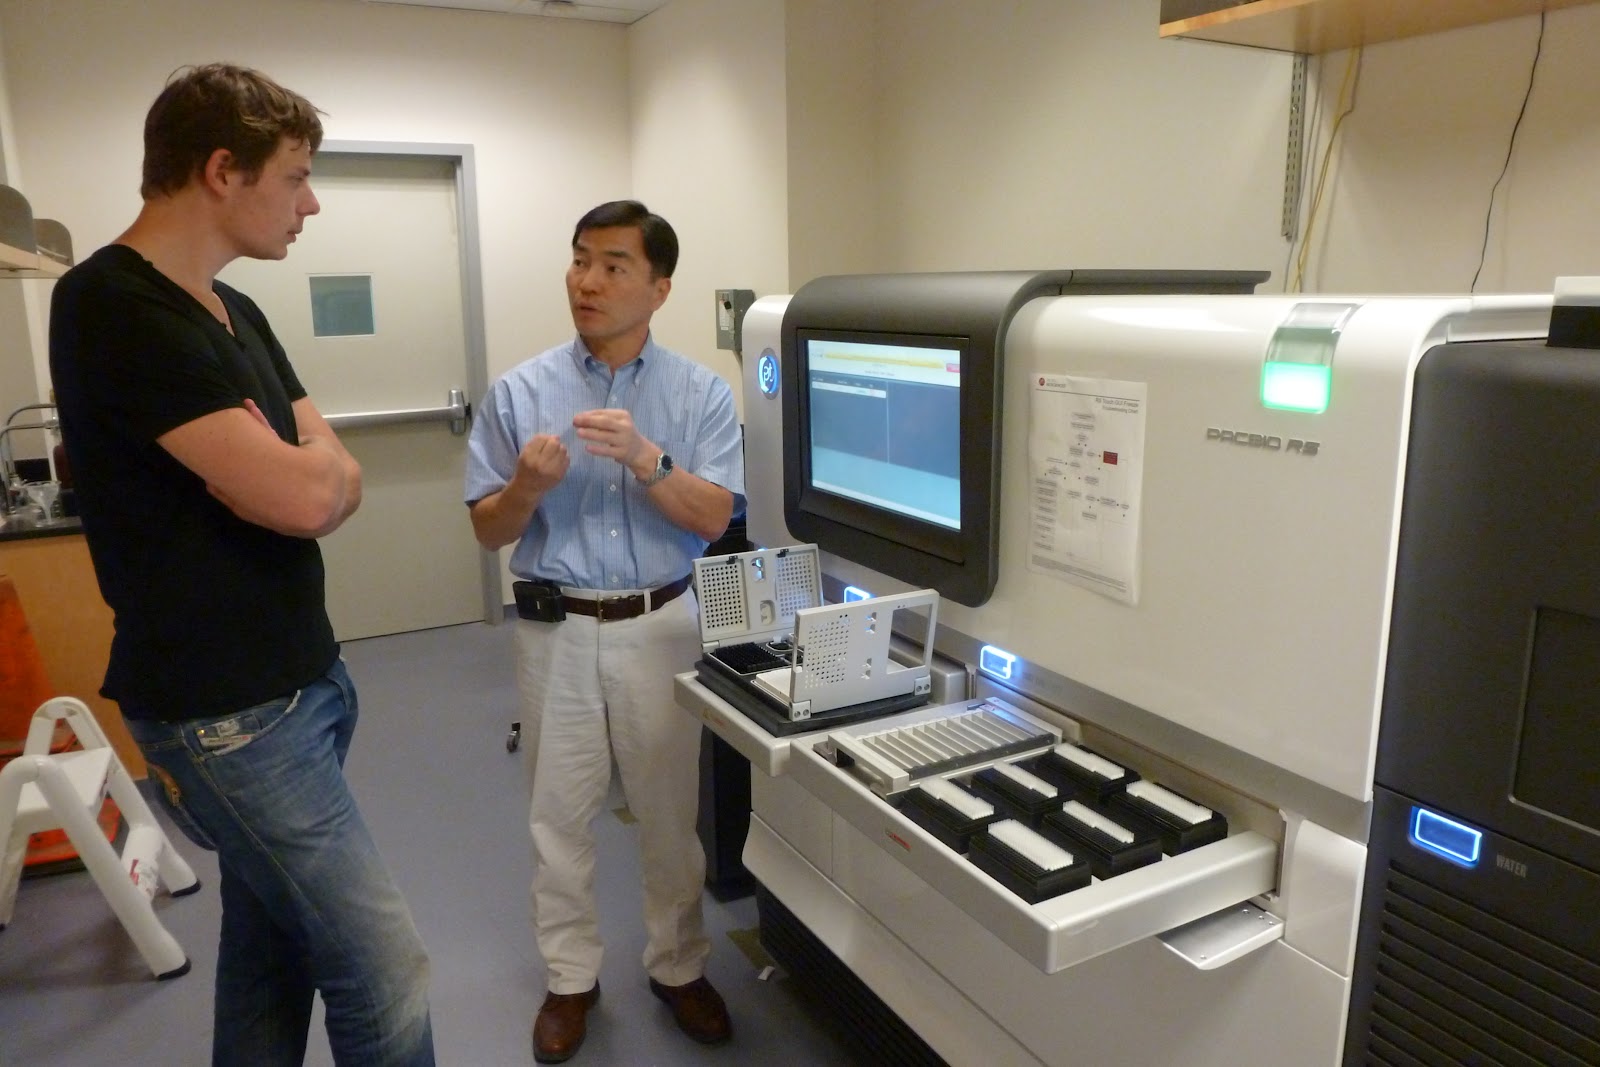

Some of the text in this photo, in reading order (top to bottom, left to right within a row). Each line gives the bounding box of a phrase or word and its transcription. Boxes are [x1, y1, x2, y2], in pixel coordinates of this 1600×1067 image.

[1206, 427, 1321, 456] PACBIO RS
[1496, 854, 1527, 878] WATER
